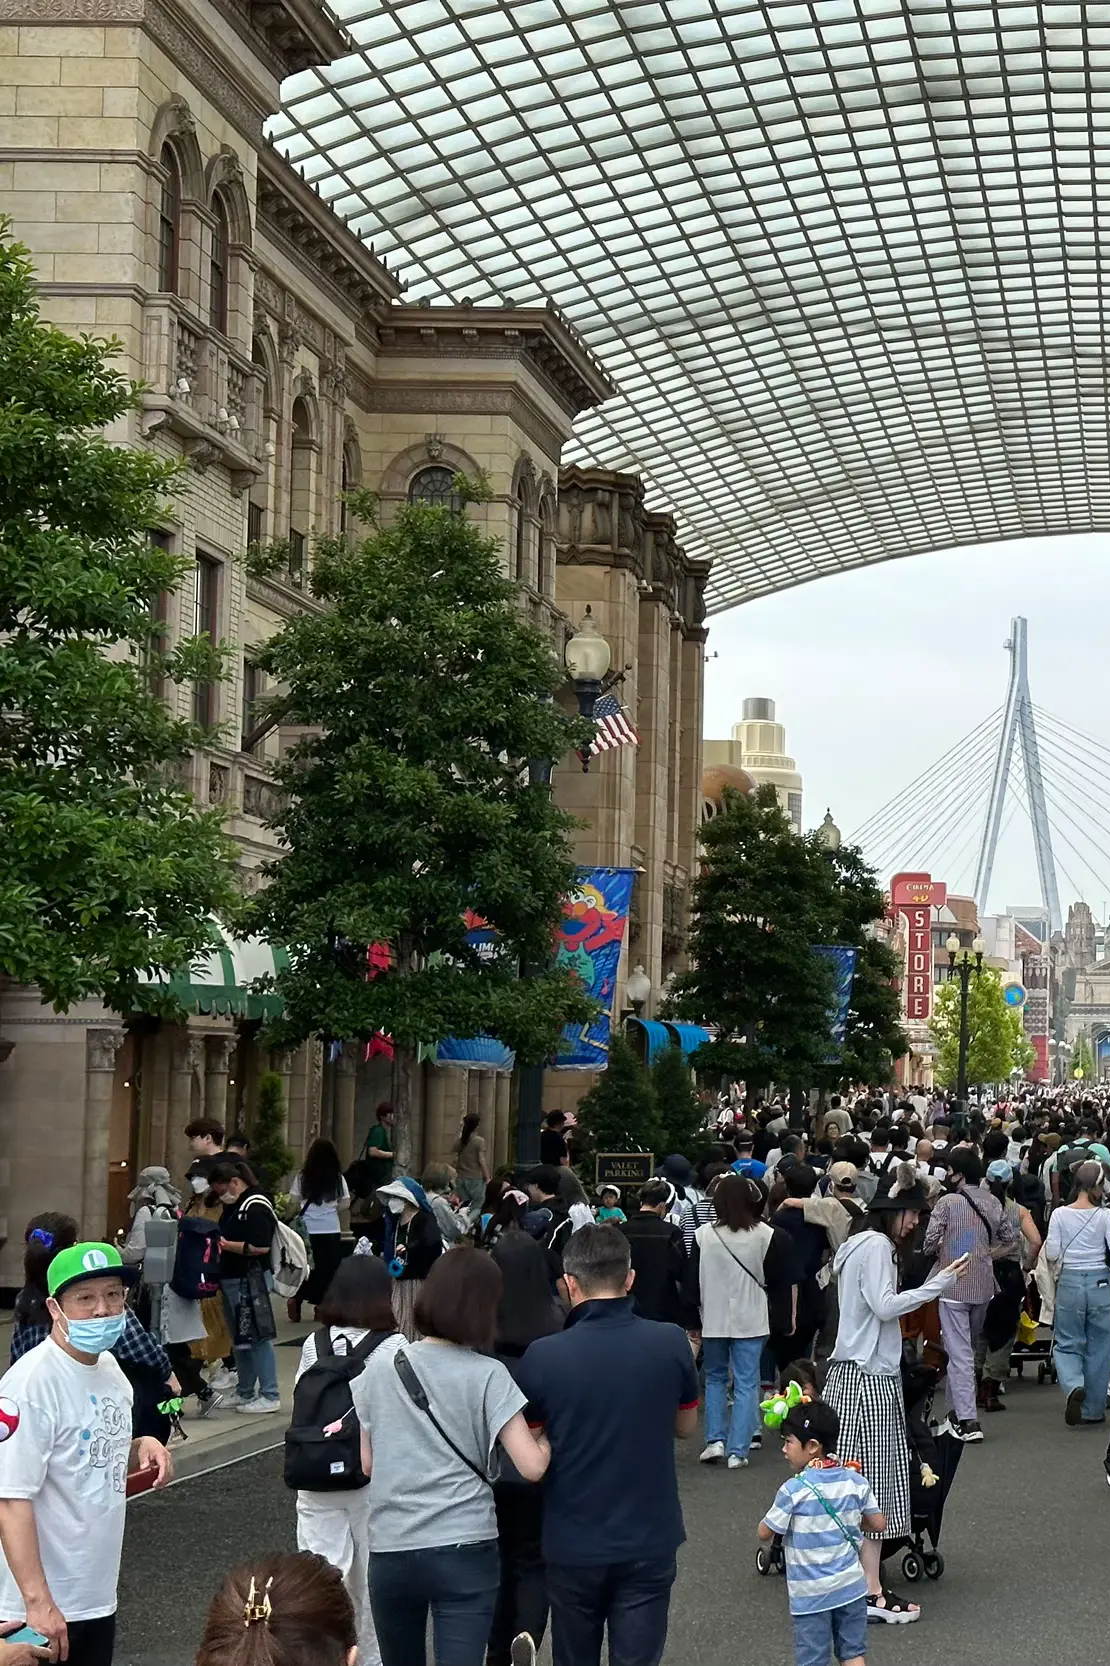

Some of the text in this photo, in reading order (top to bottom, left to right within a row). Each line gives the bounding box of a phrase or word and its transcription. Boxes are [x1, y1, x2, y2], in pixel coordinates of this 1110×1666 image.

[914, 910, 924, 1015] STORE
[610, 1161, 639, 1169] VALET
[604, 1169, 644, 1177] PARKING
[88, 1253, 105, 1268] L
